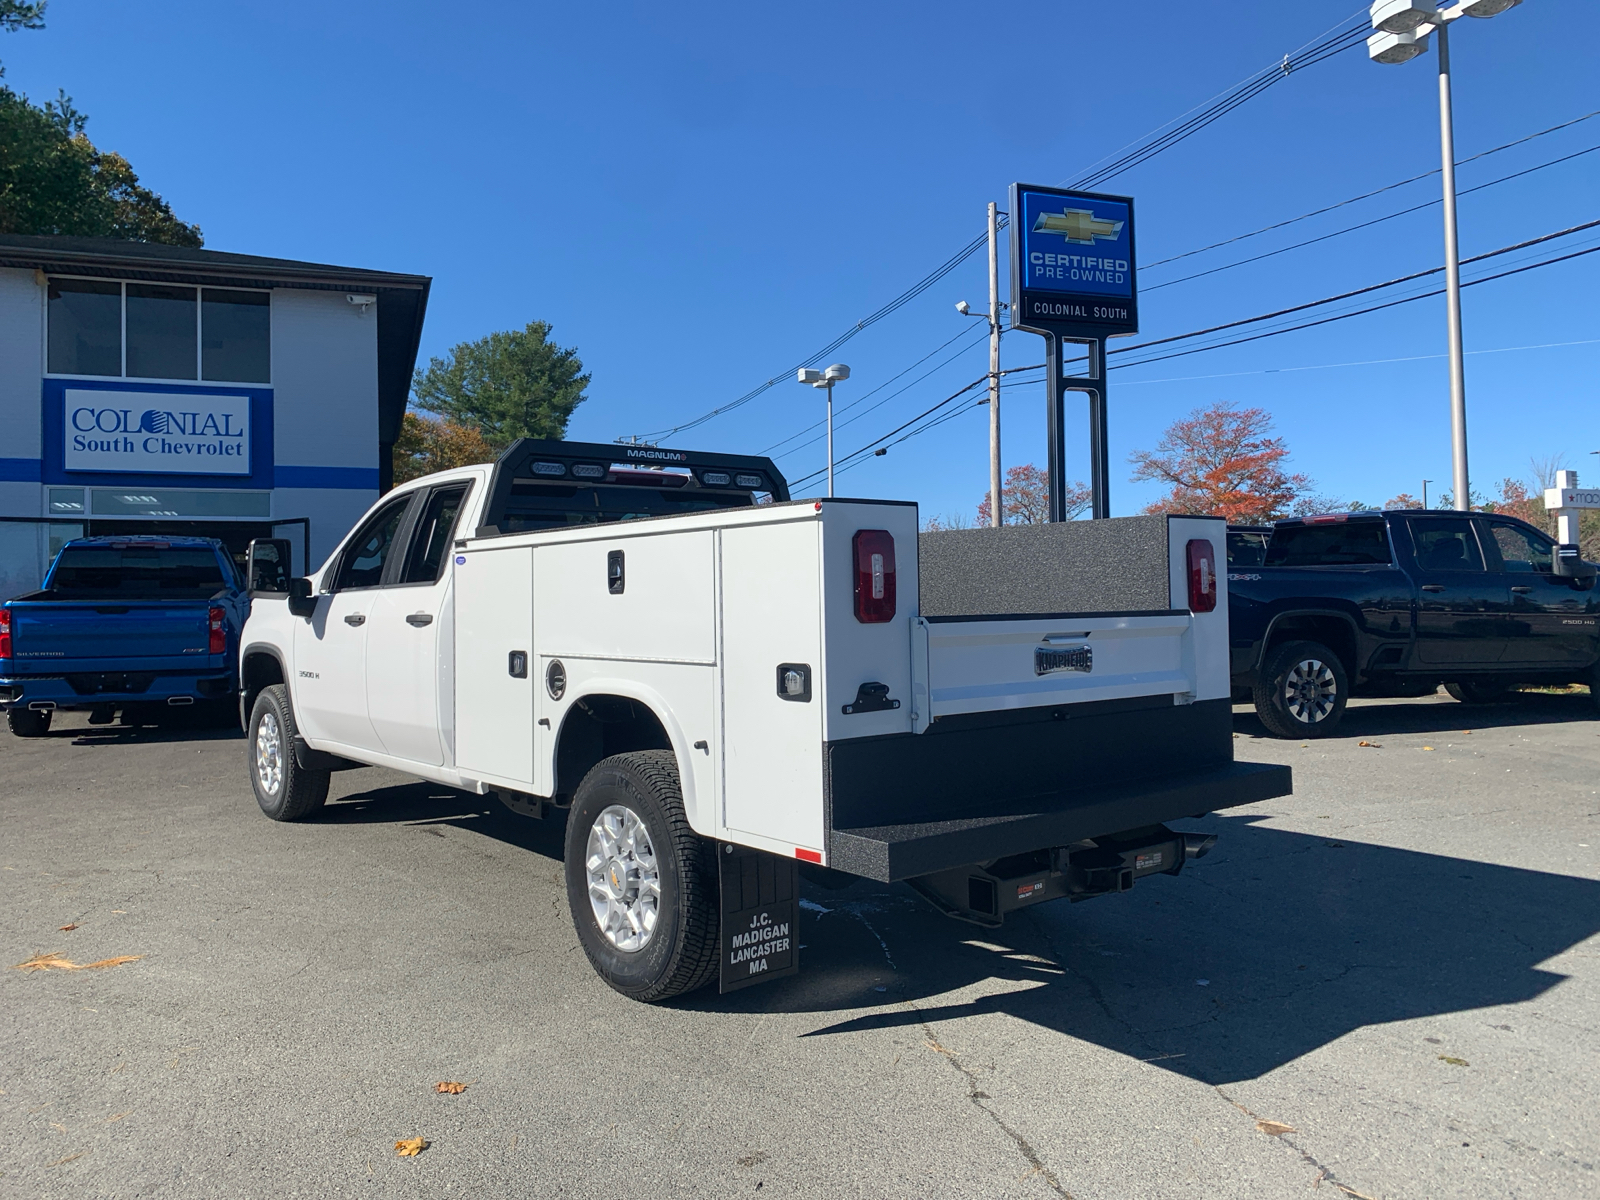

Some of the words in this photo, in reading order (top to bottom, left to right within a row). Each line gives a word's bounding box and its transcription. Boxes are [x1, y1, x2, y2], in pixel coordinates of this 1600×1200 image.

[1030, 252, 1128, 272] CERTIFIED
[1035, 266, 1124, 284] PRE-OWNED
[1034, 302, 1088, 317] COLONIAL
[1093, 306, 1128, 319] SOUTH
[72, 407, 243, 437] COLONIAL
[73, 434, 135, 453] South
[142, 437, 243, 456] Chevrolet
[627, 449, 681, 461] MAGNUM
[1036, 648, 1091, 673] KNAPHEIDE
[299, 670, 315, 679] 3500
[749, 912, 772, 929] J.C.
[732, 923, 789, 949] MADIGAN
[730, 938, 790, 965] LANCASTER
[749, 958, 768, 975] MA
